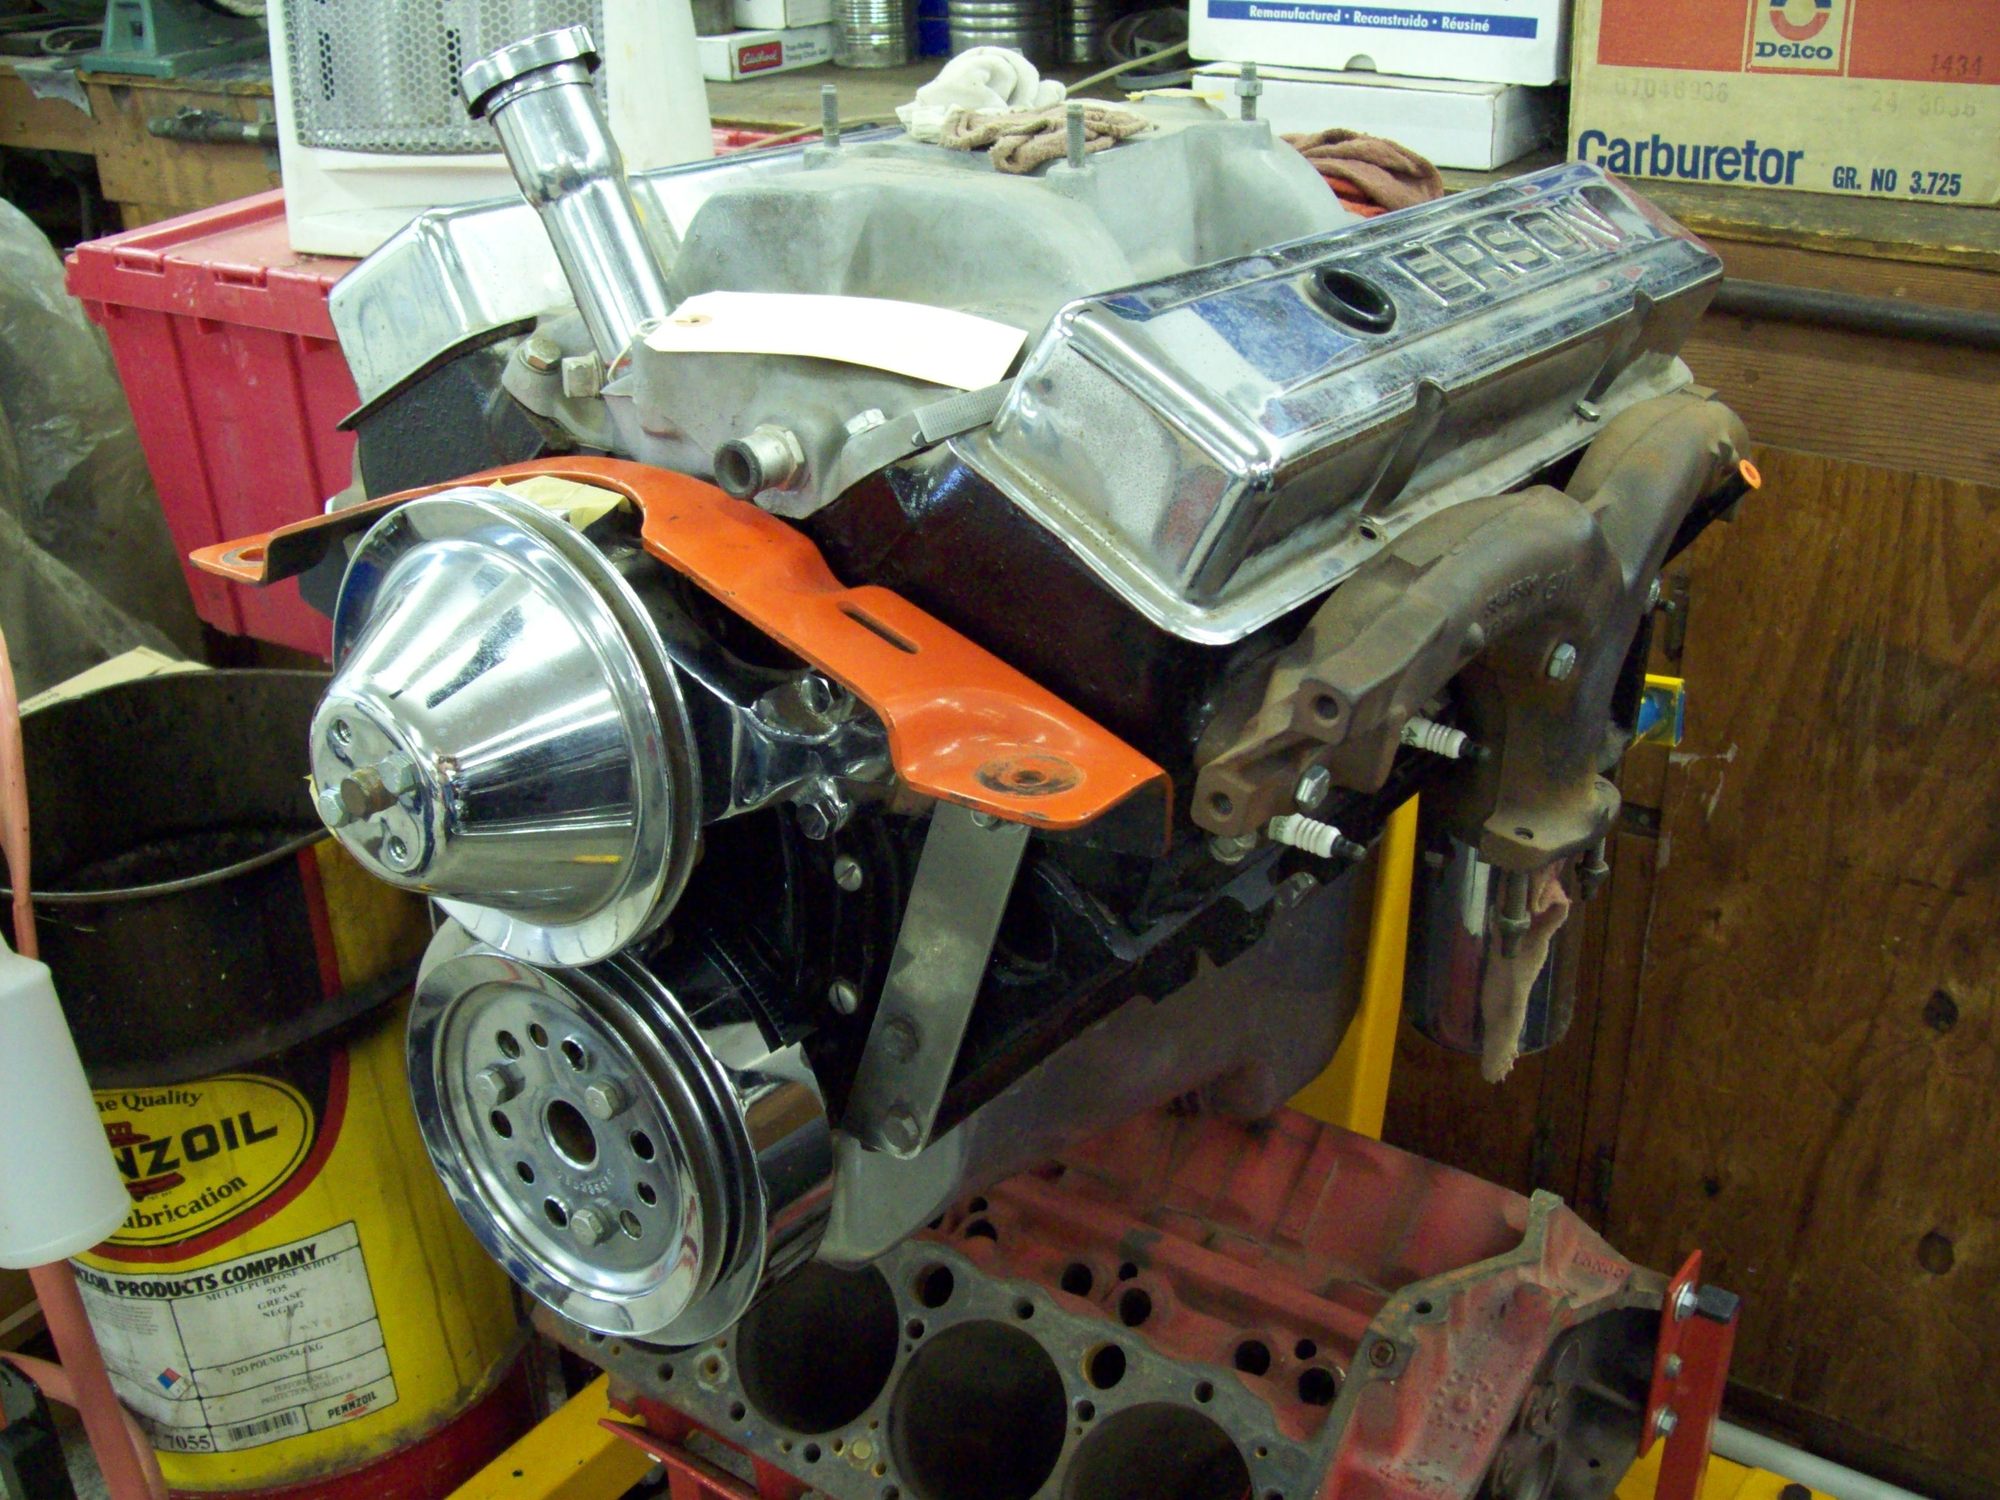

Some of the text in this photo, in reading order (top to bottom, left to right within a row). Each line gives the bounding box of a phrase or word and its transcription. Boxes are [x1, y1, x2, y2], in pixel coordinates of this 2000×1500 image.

[1249, 5, 1490, 32] Remanufactured Reconstruido Réusiné
[1755, 41, 1834, 60] Delco
[1577, 130, 1804, 185] Carburetor
[1832, 165, 1962, 197] GR. NO 3.725
[122, 1090, 203, 1113] Quality
[114, 1111, 279, 1180] NZOIL
[121, 1176, 248, 1229] ubrication
[115, 1273, 219, 1298] PRODUCTS
[221, 1243, 318, 1285] COMPANY
[327, 1391, 378, 1420] PENNZOIL
[164, 1434, 211, 1450] 7055
